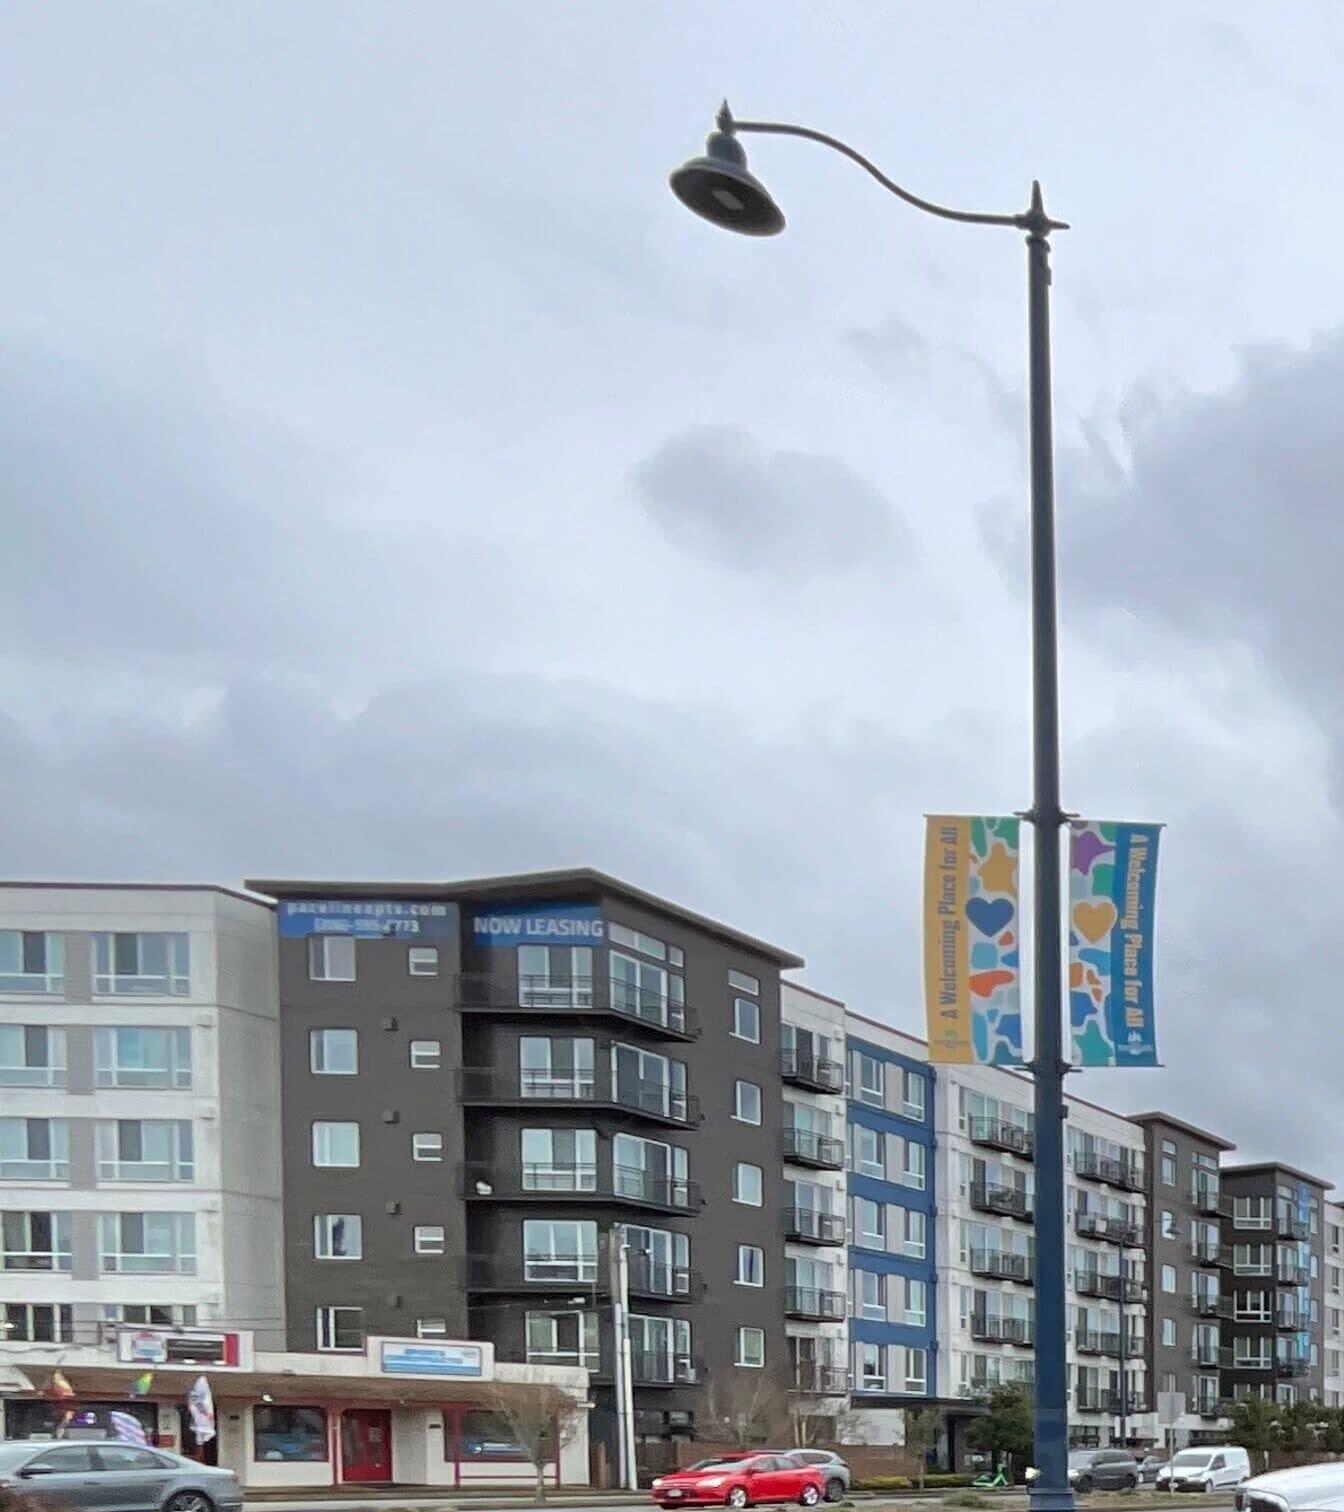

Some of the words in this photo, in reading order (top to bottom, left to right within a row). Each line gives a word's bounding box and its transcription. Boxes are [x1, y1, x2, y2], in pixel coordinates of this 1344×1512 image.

[940, 827, 958, 845] All
[1130, 833, 1149, 843] A
[939, 847, 957, 869] for
[938, 875, 956, 915] Place
[1120, 847, 1148, 929] Welcoming
[474, 917, 521, 934] NOW
[526, 918, 603, 936] LEASING
[938, 919, 960, 1004] Welcoming
[1124, 933, 1143, 975] Place
[1124, 980, 1143, 1003] for
[940, 1008, 958, 1019] A
[1125, 1007, 1145, 1027] All
